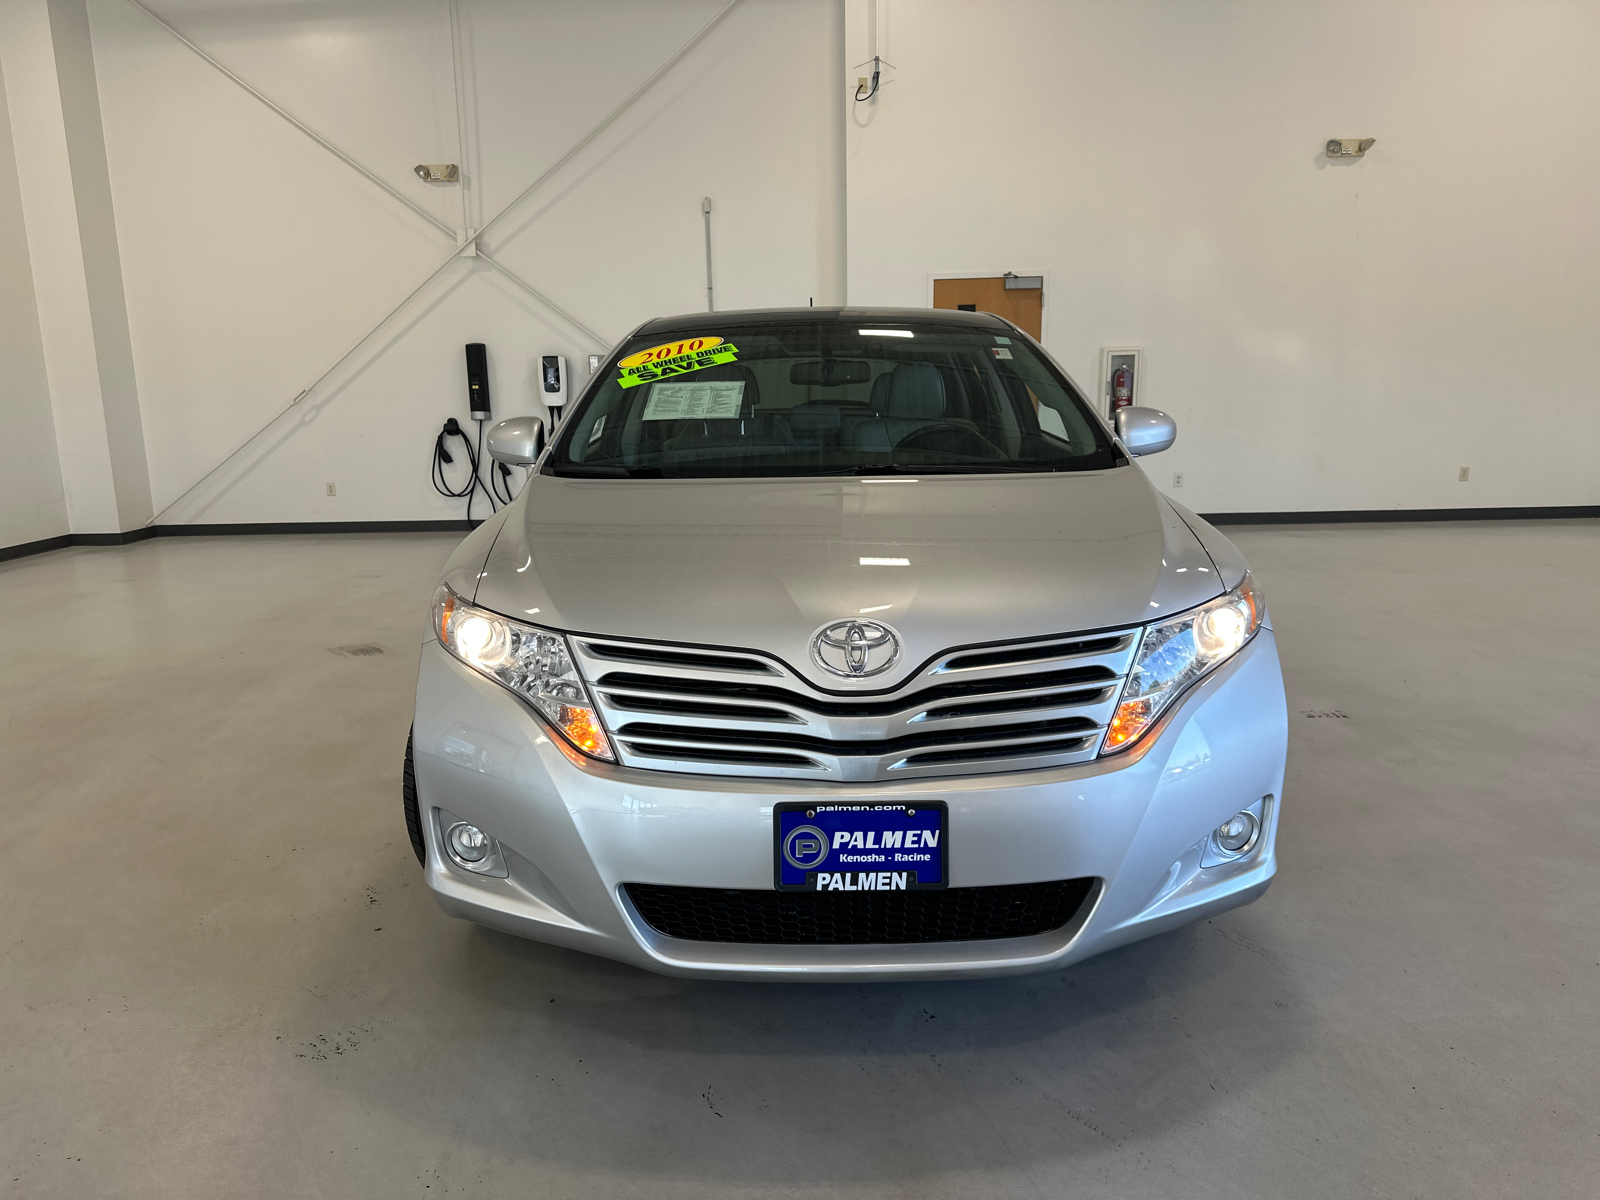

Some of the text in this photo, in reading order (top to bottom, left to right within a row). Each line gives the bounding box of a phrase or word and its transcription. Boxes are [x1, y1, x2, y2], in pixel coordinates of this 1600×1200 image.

[628, 345, 734, 376] ALL WHEEL DRIVE
[640, 339, 704, 365] 2010
[637, 357, 718, 381] SAVE
[816, 804, 906, 813] palmen.com
[795, 839, 821, 858] P
[832, 829, 940, 849] PALMEN
[839, 853, 885, 863] Kenosha
[894, 852, 931, 862] Racine
[816, 871, 908, 891] PALMEN
